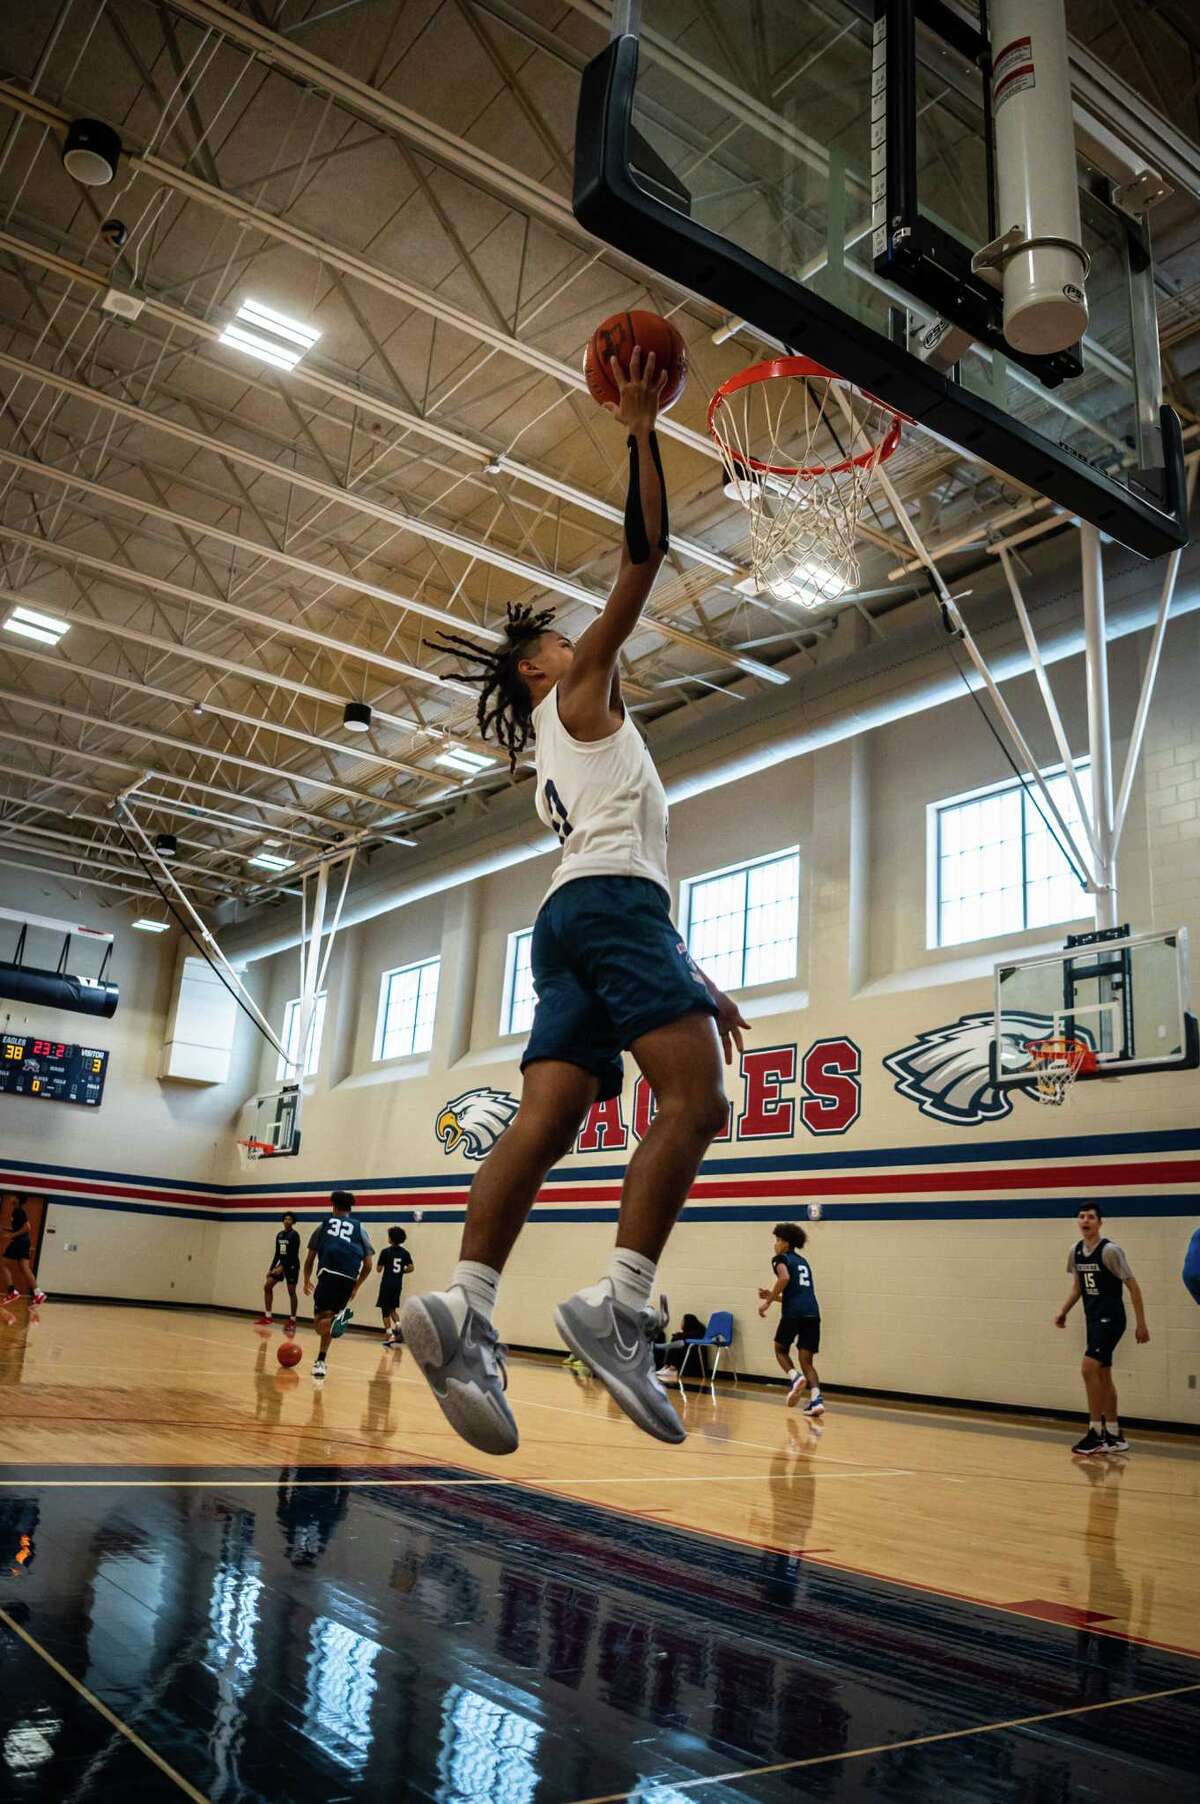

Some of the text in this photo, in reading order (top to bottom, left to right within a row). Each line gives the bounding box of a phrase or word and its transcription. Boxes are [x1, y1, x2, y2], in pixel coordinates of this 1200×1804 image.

[2, 1036, 26, 1046] EAGLES
[5, 1044, 23, 1060] 38
[81, 1048, 105, 1059] VISITOR
[92, 1059, 101, 1072] 3
[568, 1036, 862, 1154] AES
[327, 1217, 354, 1243] 32
[392, 1258, 402, 1274] 5
[798, 1264, 811, 1287] 2
[1084, 1272, 1096, 1288] 15
